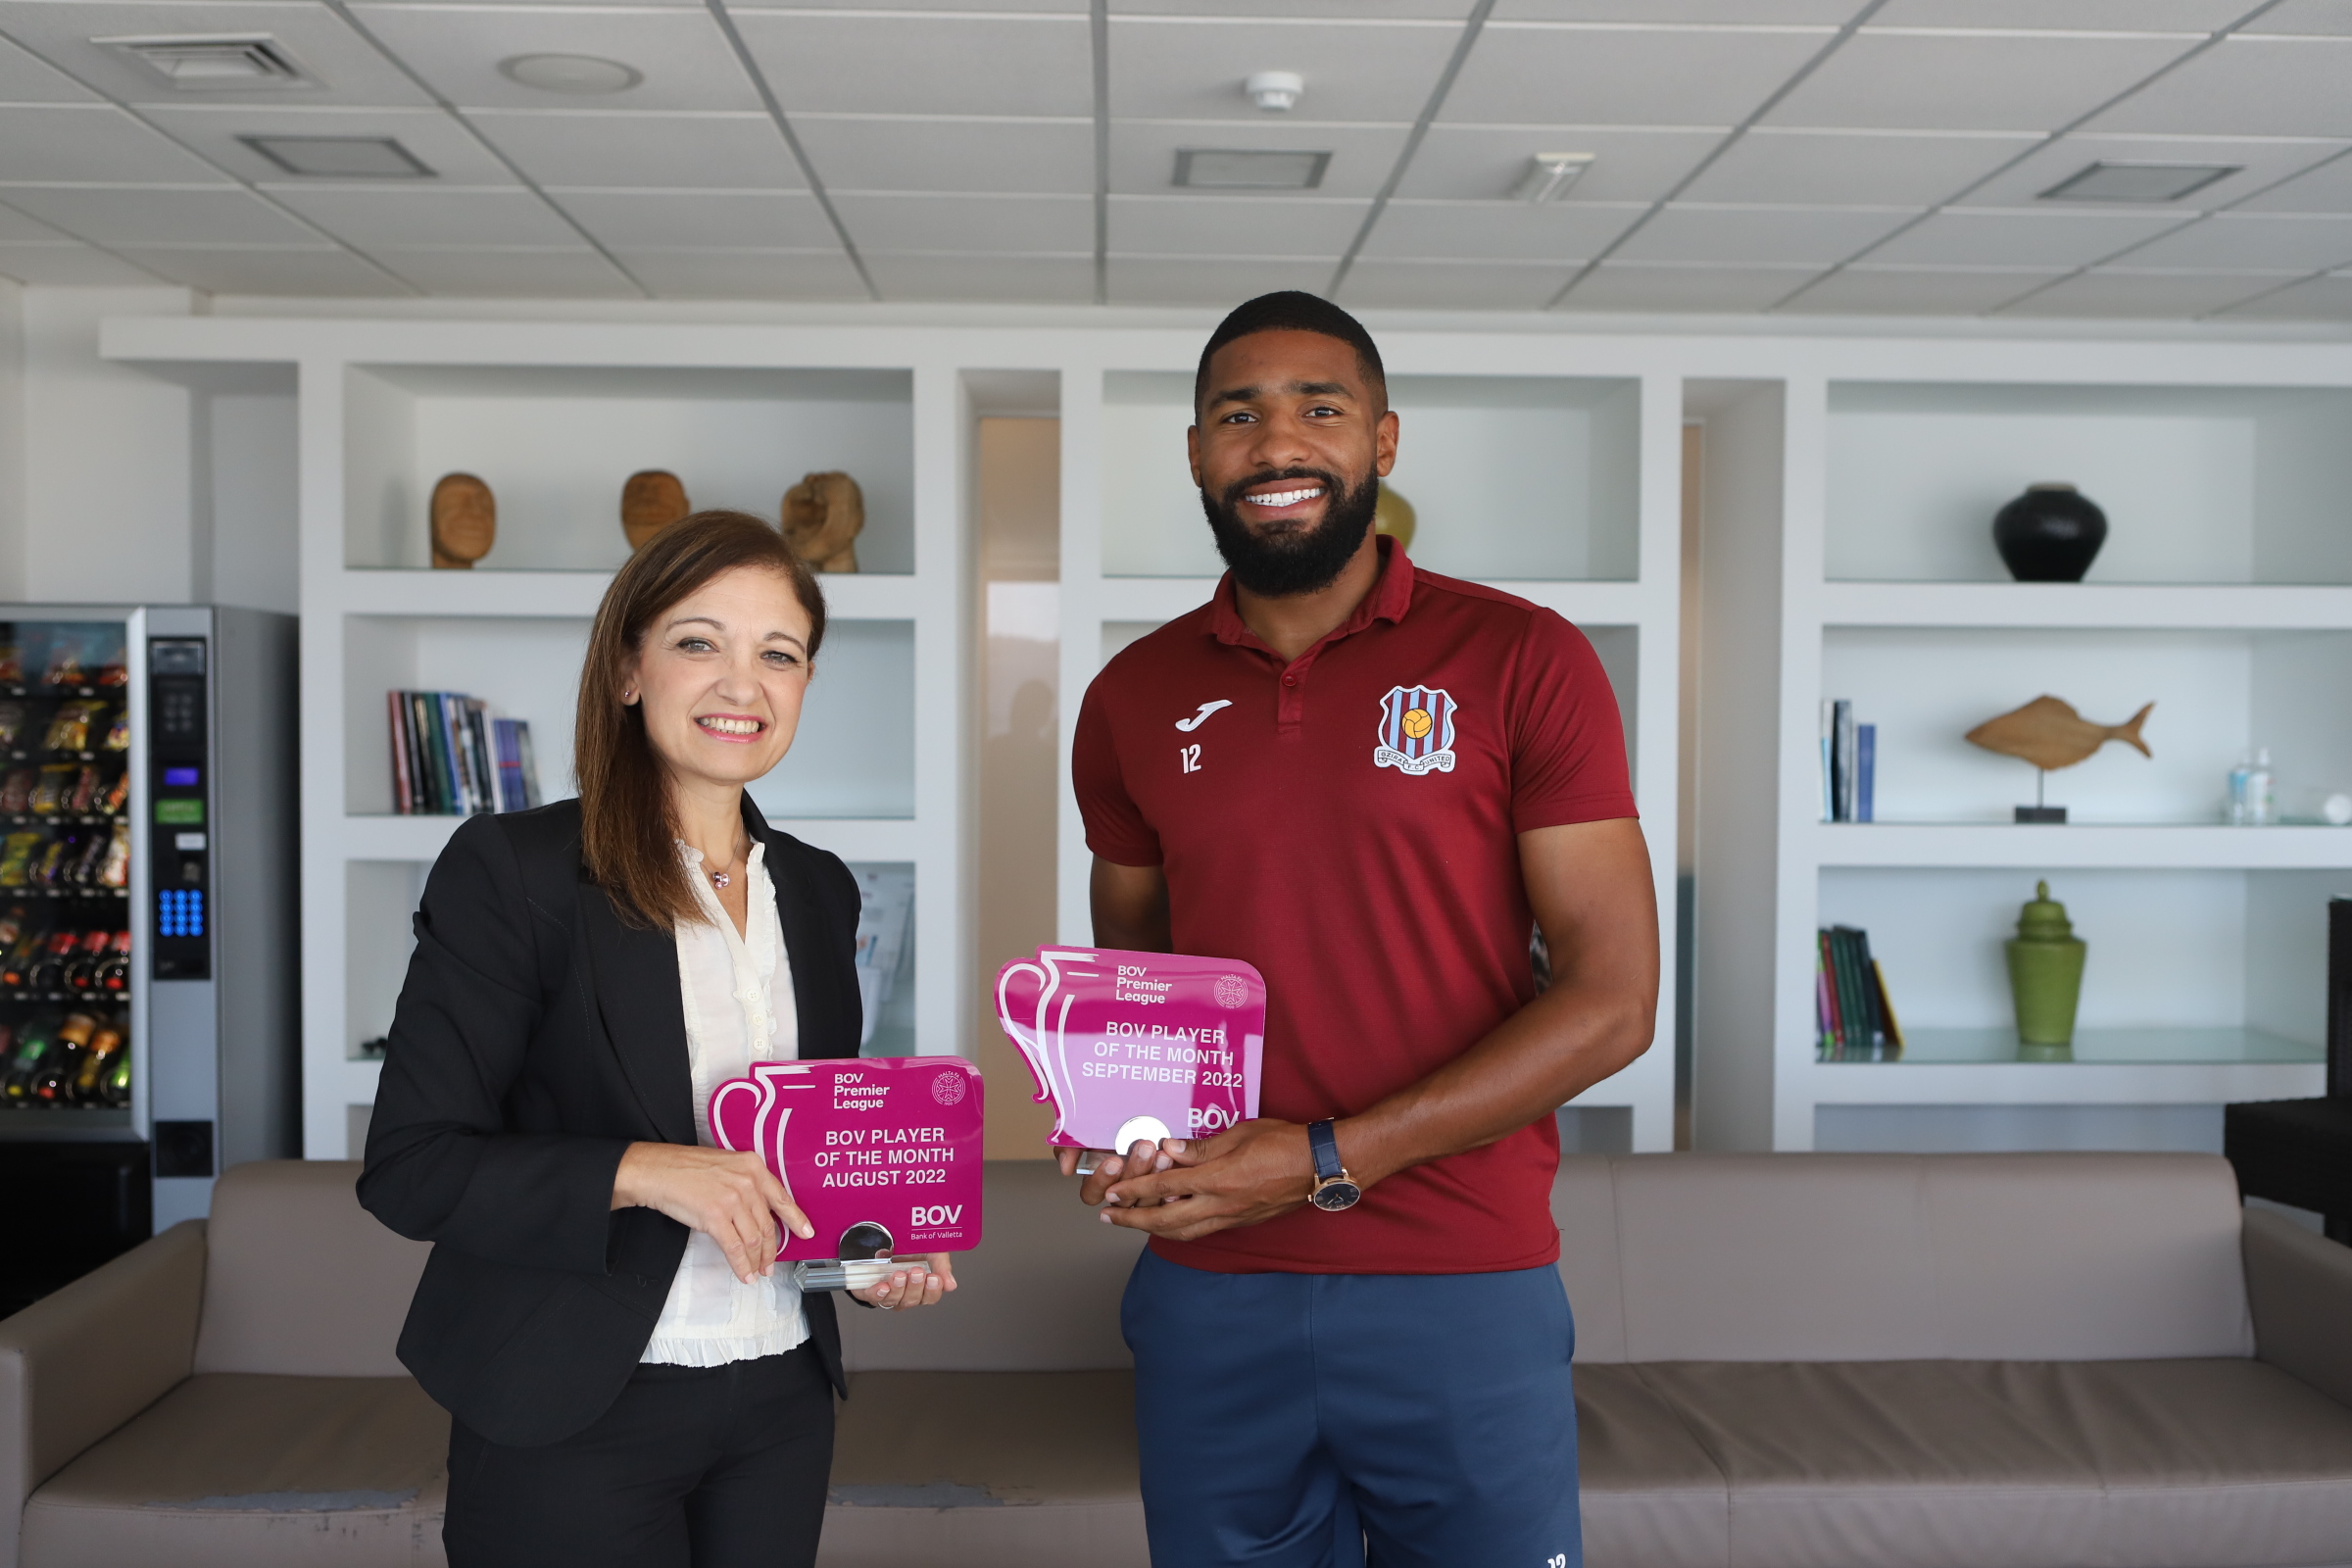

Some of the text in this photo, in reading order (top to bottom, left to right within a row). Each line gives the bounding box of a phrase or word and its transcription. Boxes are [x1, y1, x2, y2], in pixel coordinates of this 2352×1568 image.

[1180, 744, 1201, 773] 12
[1424, 756, 1450, 765] UNITED
[1117, 965, 1147, 977] BOV
[1116, 977, 1172, 992] Premier
[1115, 990, 1165, 1005] League
[1105, 1021, 1225, 1045] BOV PLAYER
[1094, 1042, 1234, 1066] OF THE MONTH
[834, 1073, 863, 1084] BOV
[1082, 1062, 1243, 1088] SEPTEMBER 2022
[834, 1084, 890, 1096] Premier
[834, 1098, 884, 1111] League
[1188, 1107, 1240, 1129] BOV
[825, 1128, 945, 1146] BOV PLAYER
[814, 1148, 955, 1167] OF THE MONTH
[822, 1169, 946, 1188] AUGUST 2022
[911, 1204, 962, 1226] BOV
